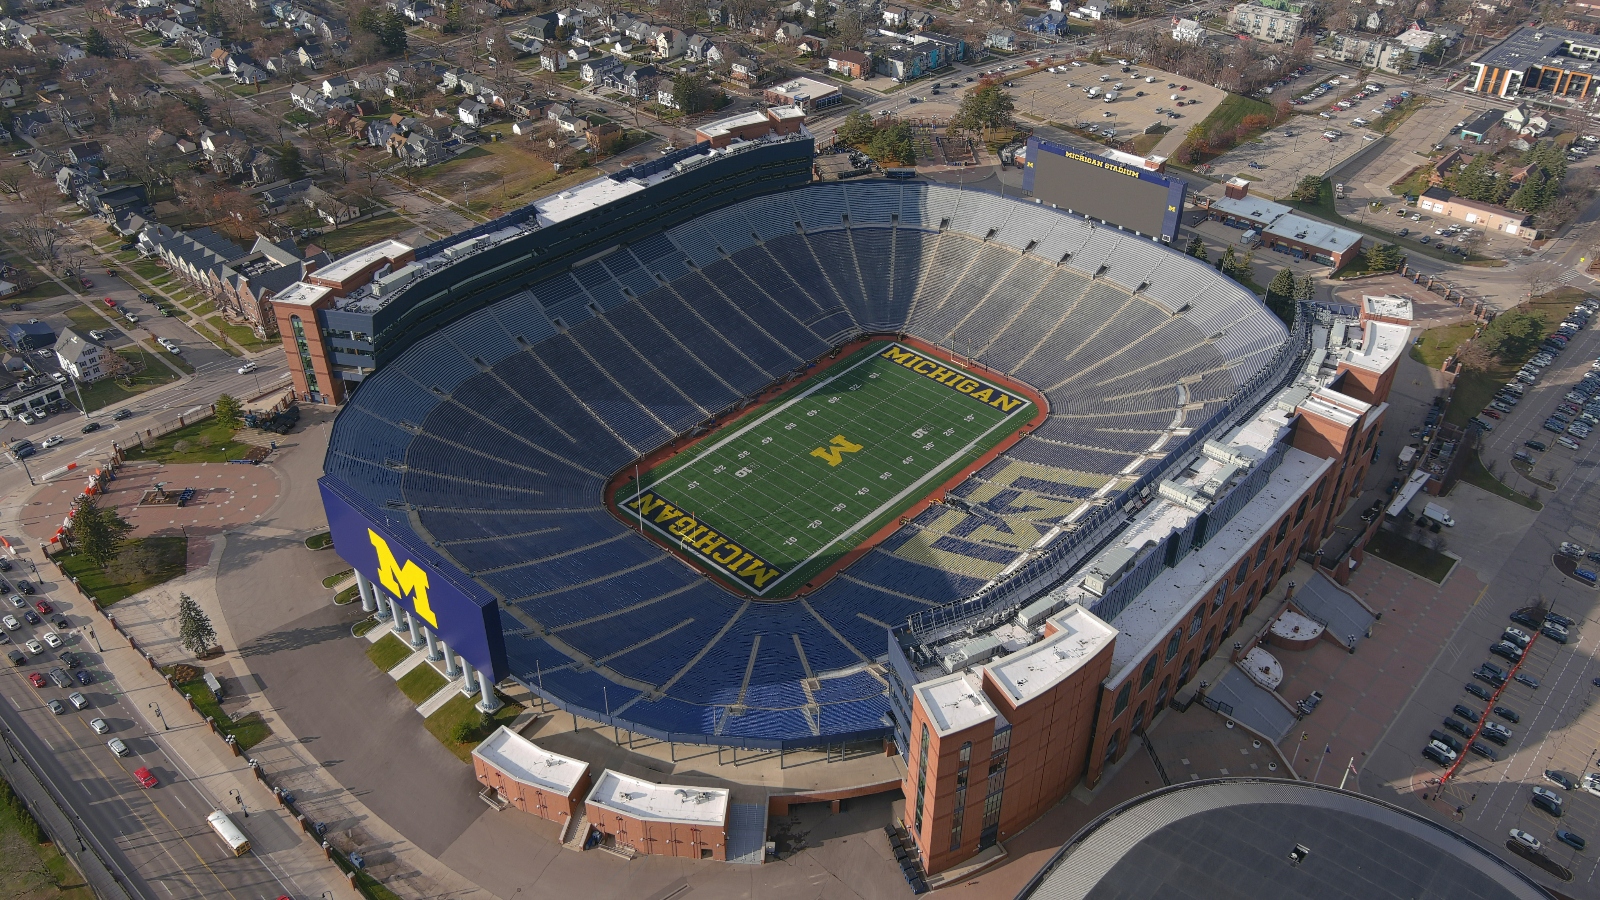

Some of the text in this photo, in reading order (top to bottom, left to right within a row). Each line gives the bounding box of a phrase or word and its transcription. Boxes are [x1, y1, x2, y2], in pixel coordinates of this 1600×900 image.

[1027, 161, 1034, 169] M
[1065, 150, 1140, 179] MICHIGAN STADIUM
[1168, 204, 1176, 212] M
[881, 346, 1022, 412] MICHIGAN
[809, 433, 864, 467] M
[628, 493, 780, 588] MICHIGAN
[367, 527, 439, 630] M
